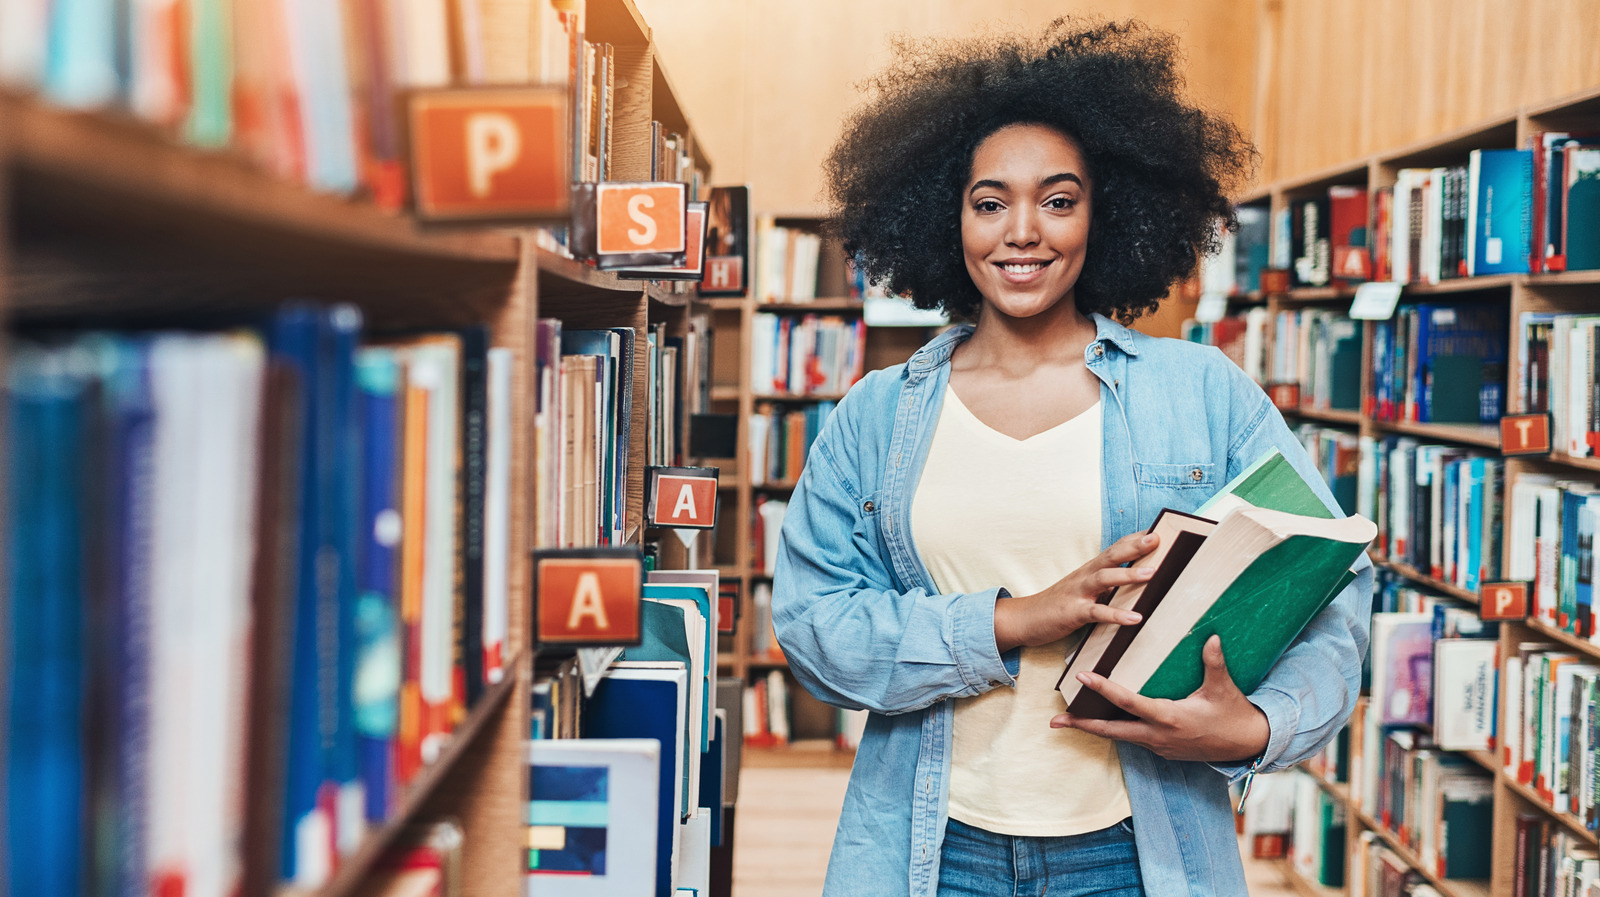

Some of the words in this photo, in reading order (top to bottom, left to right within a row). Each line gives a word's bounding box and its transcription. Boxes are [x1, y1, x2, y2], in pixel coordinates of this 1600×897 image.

[465, 112, 521, 199] P
[627, 194, 658, 246] S
[713, 258, 730, 285] H
[1513, 418, 1534, 449] T
[671, 483, 697, 519] A
[568, 571, 609, 630] A
[1494, 587, 1514, 616] P
